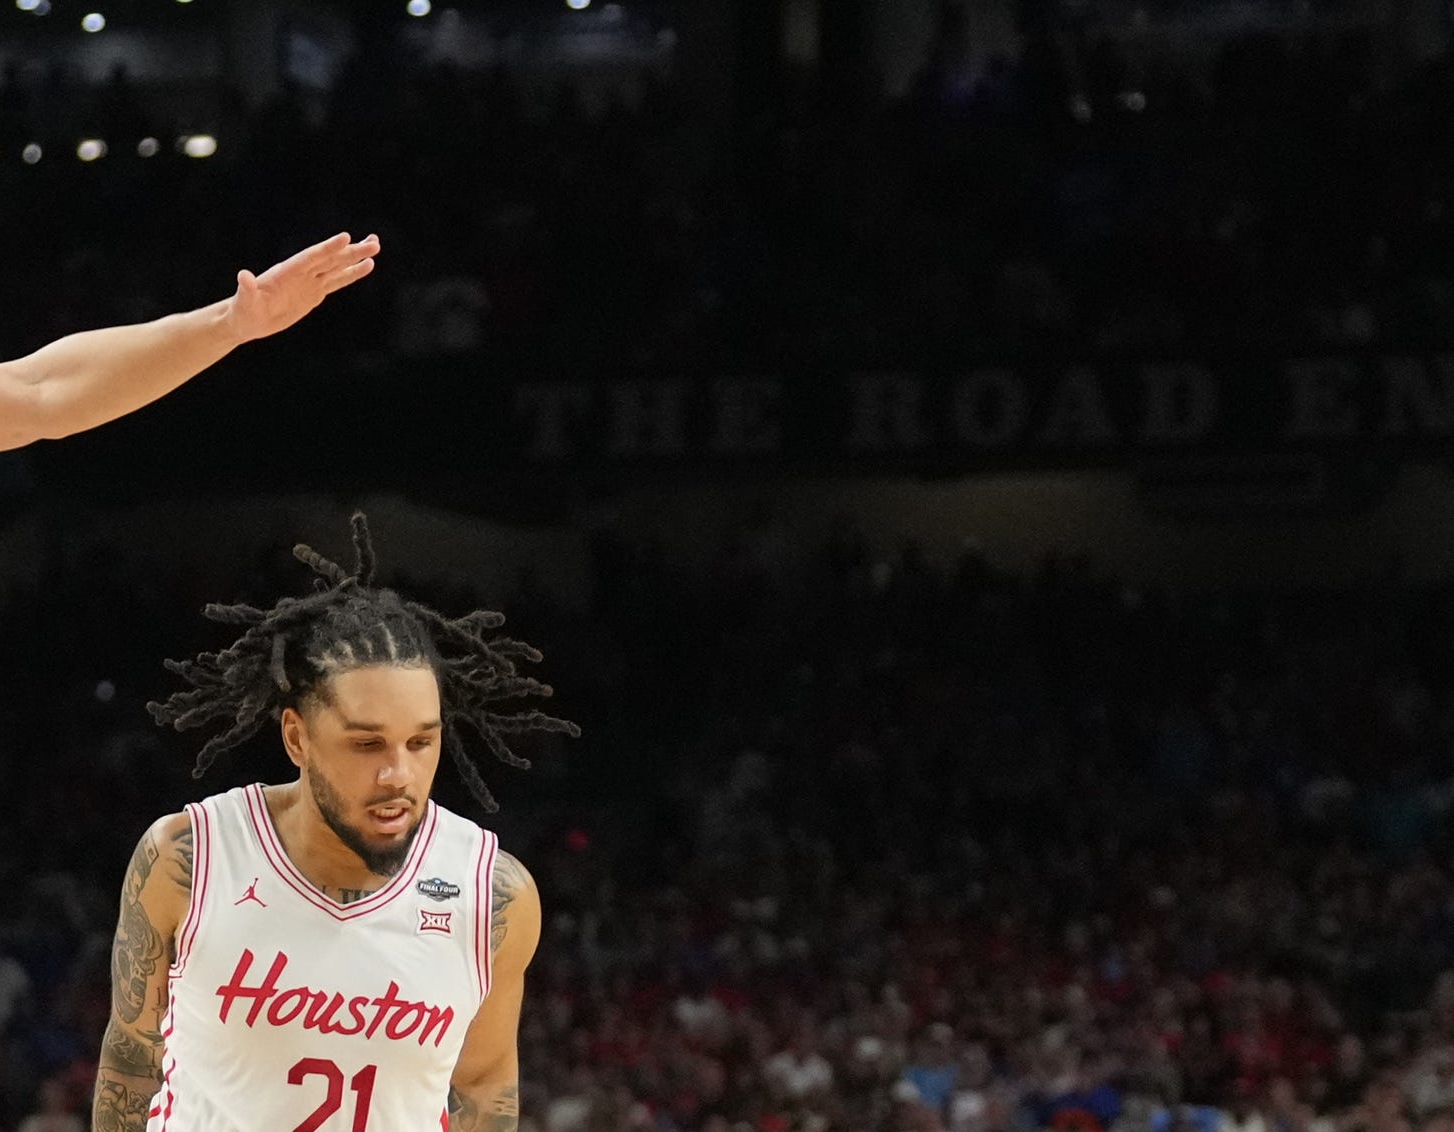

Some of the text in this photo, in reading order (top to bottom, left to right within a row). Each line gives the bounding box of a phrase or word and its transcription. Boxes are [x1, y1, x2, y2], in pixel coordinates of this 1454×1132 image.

[513, 378, 784, 459] THE
[843, 362, 1219, 449] ROAD
[419, 882, 459, 894] FINAL FOUR
[216, 948, 455, 1048] Houston
